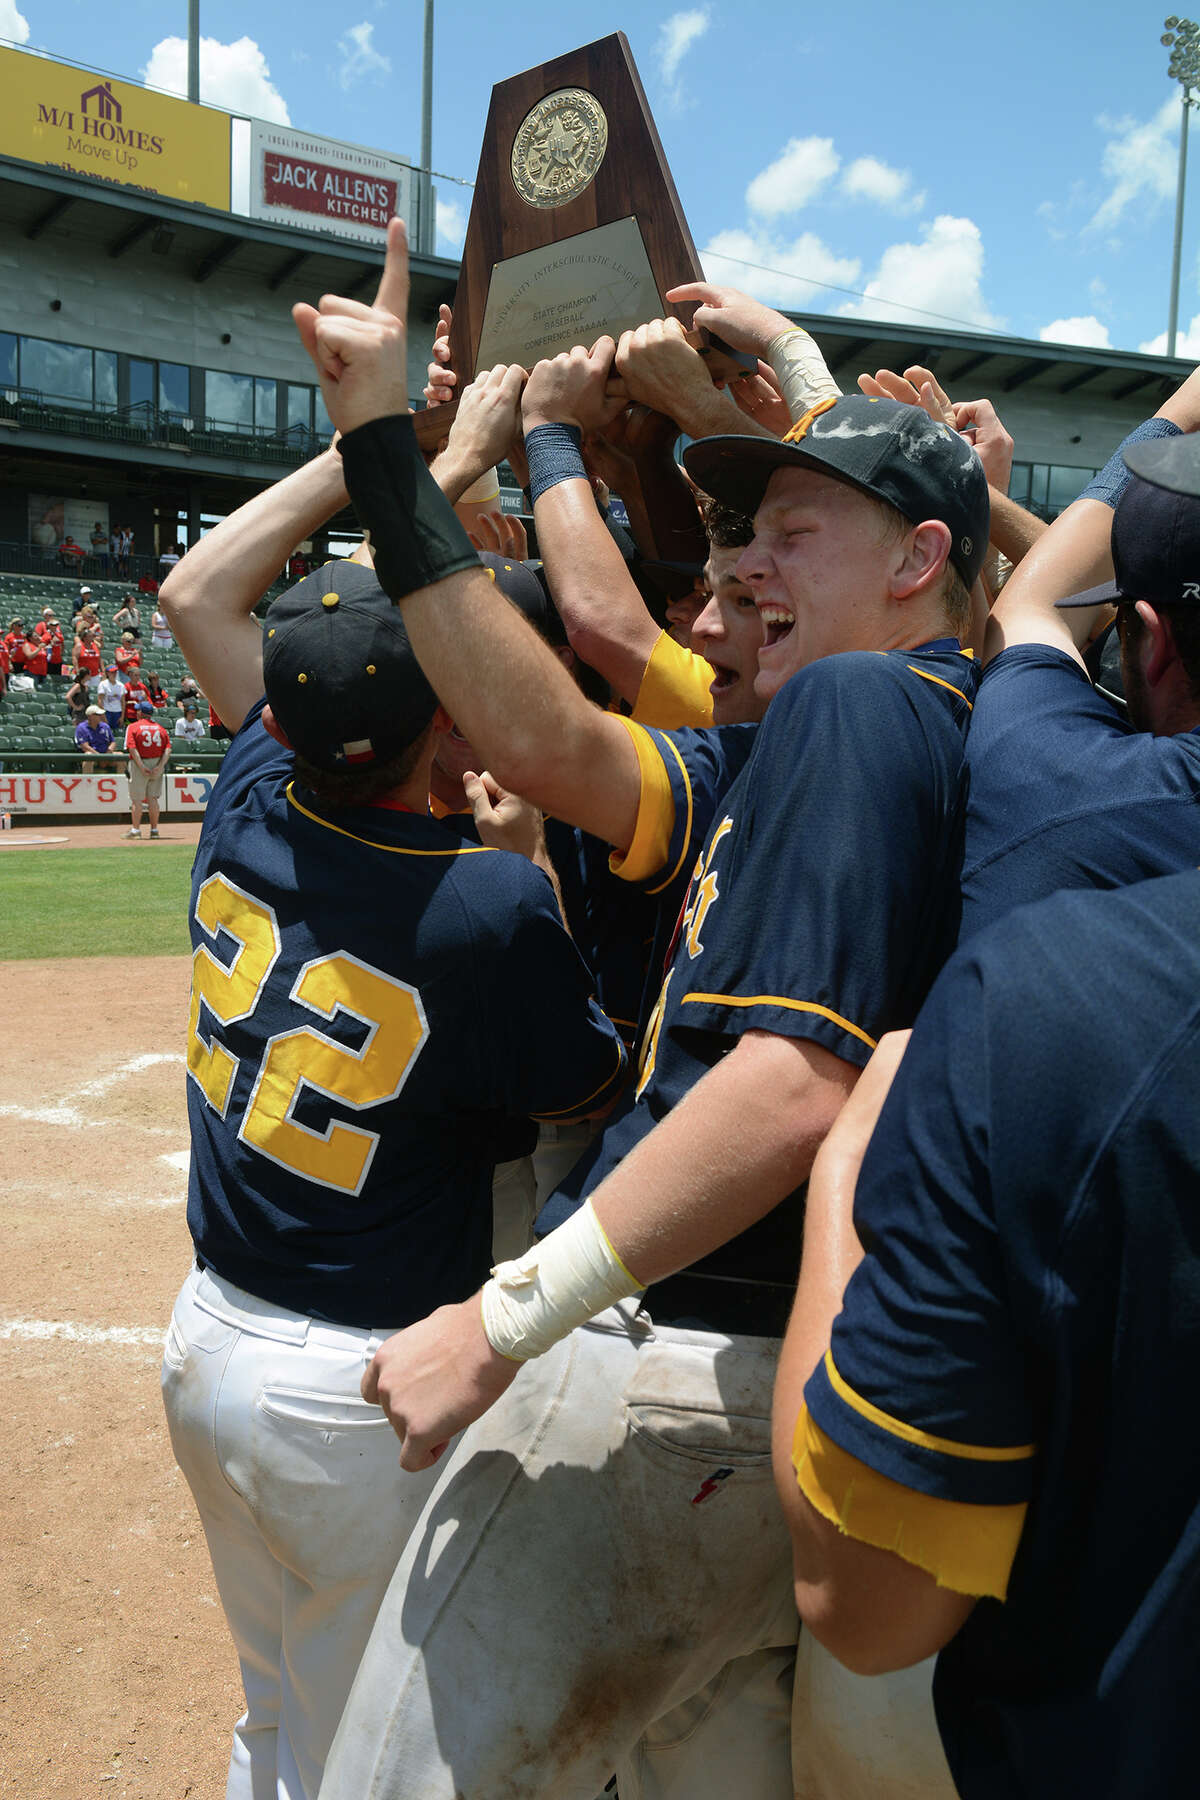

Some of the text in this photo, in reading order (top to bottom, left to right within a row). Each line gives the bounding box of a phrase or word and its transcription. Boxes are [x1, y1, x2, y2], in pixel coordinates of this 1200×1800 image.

[37, 103, 163, 155] M/I HOMES
[67, 135, 138, 171] Move Up
[272, 162, 389, 208] JACK ALLEN'S
[327, 198, 388, 224] KITCHEN
[611, 262, 641, 289] LEAGUE
[532, 293, 598, 321] STATE CHAMPION
[544, 312, 585, 330] BASEBALL
[524, 329, 572, 351] CONFERENCE
[141, 729, 162, 747] 34
[0, 778, 117, 804] HUY'S
[186, 870, 431, 1198] 22
